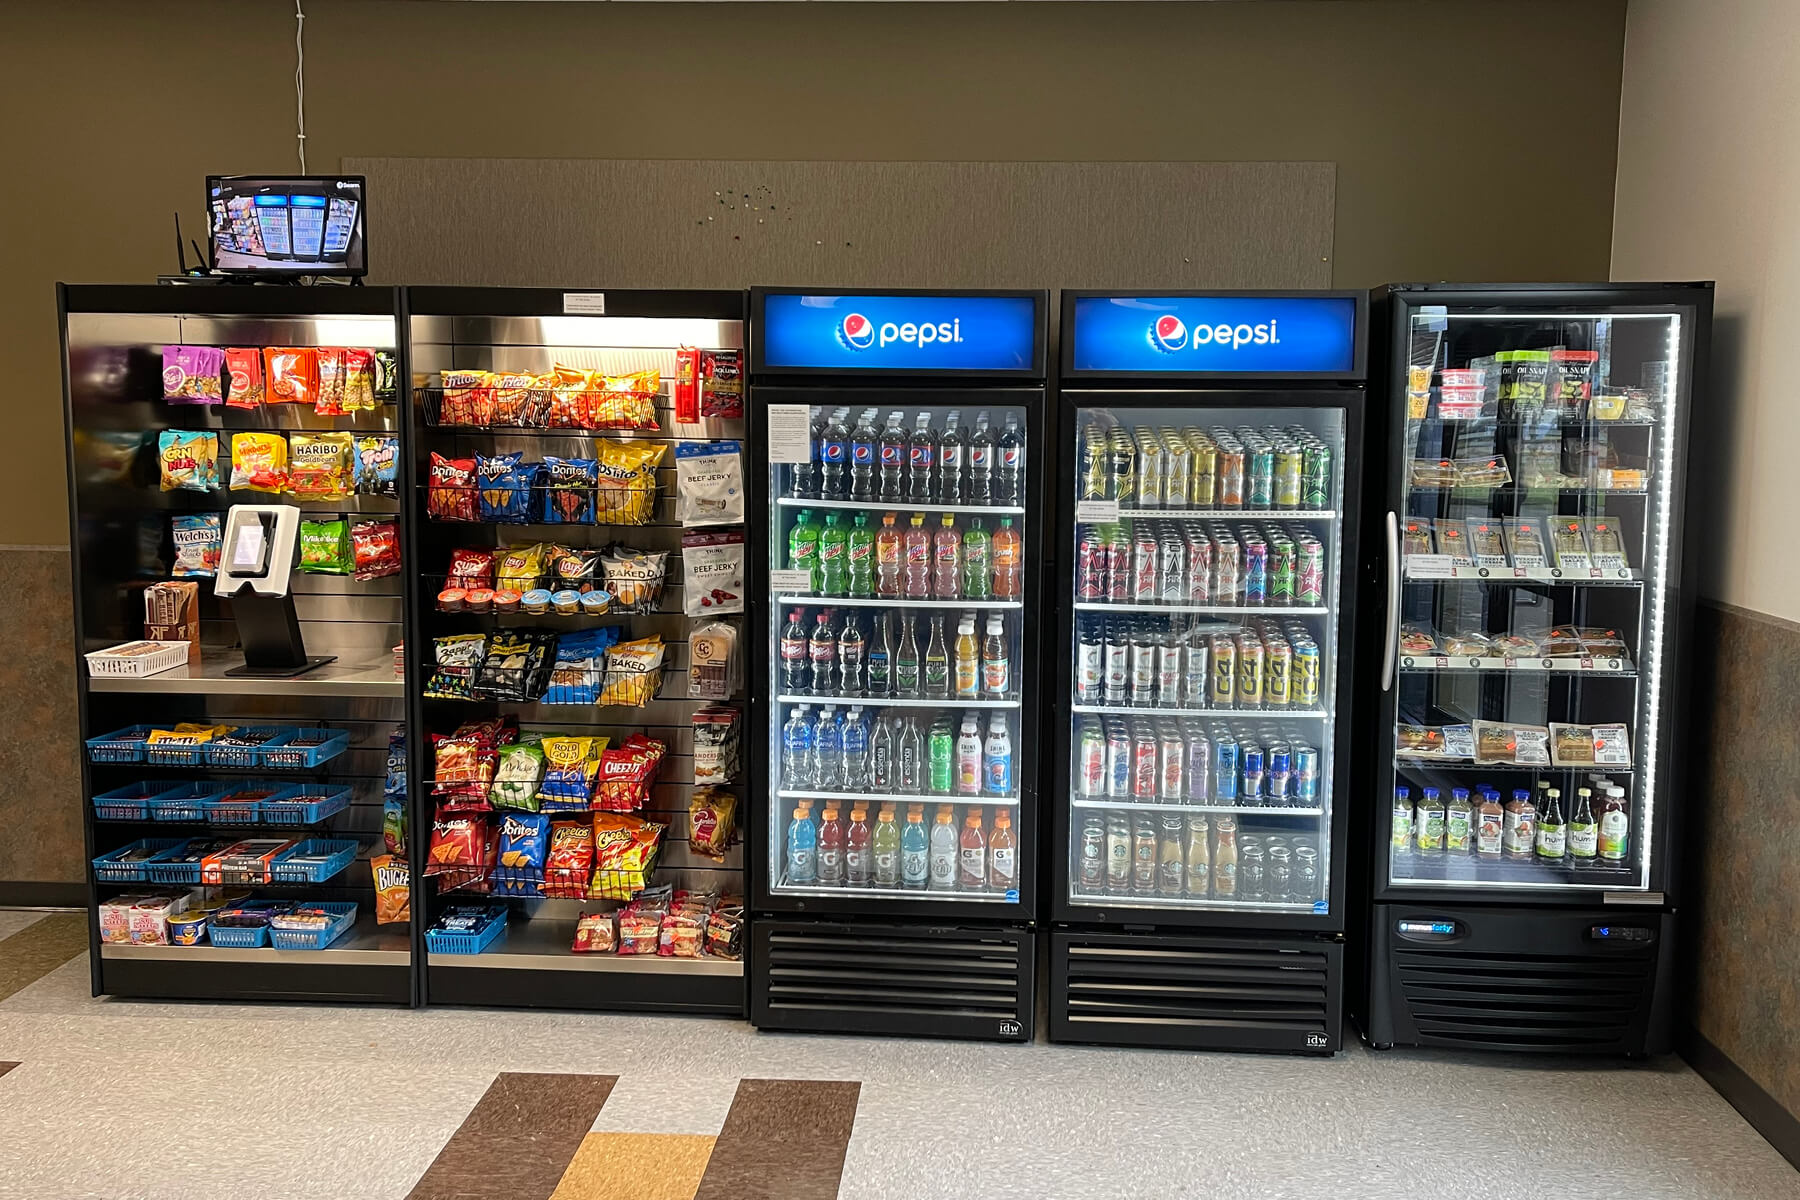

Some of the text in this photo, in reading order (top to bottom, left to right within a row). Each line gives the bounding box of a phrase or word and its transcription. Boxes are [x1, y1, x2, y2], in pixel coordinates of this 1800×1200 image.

[880, 318, 963, 348] pepsi
[1193, 319, 1280, 350] pepsi
[162, 445, 192, 462] CORN
[297, 445, 338, 455] HARIBO
[168, 457, 197, 471] NUTS
[479, 464, 513, 477] Doritos
[551, 464, 588, 477] Doritos
[432, 465, 469, 479] Doritos
[687, 472, 732, 483] BEEF JERKY
[175, 530, 209, 543] Welch's
[608, 569, 646, 579] BAKED
[693, 562, 738, 574] BEEF JERKY
[611, 659, 646, 671] BAKED
[554, 743, 578, 752] ROLD
[552, 751, 578, 759] GOLD
[604, 761, 642, 774] CHEEZ-IT
[553, 827, 591, 847] Cheetos
[847, 852, 859, 866] G
